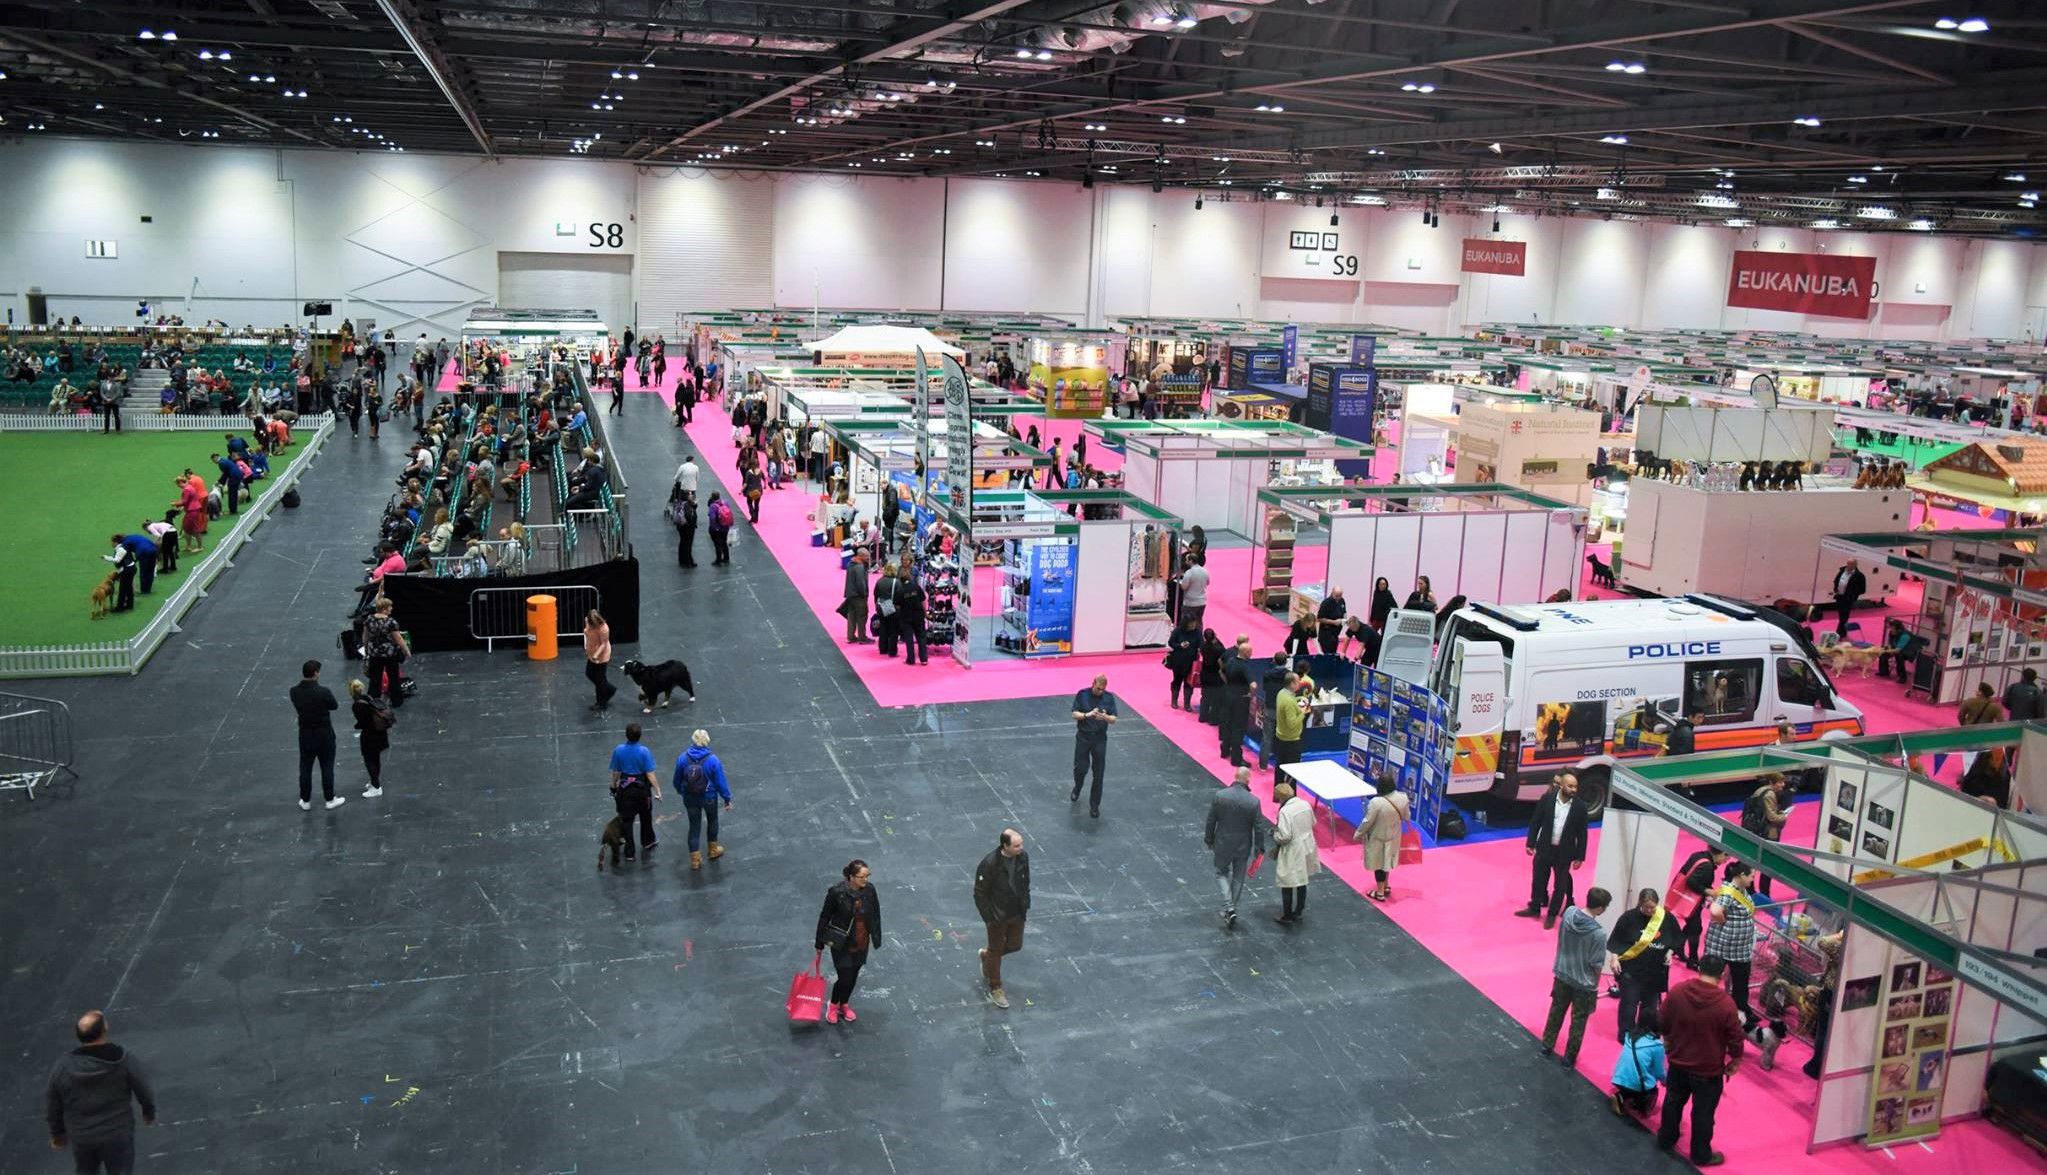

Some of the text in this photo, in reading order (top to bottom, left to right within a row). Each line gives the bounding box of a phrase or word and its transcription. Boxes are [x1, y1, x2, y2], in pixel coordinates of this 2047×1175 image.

[589, 222, 624, 249] S8
[1332, 254, 1359, 277] S9
[1465, 249, 1521, 266] EUKANUBA
[1738, 269, 1860, 298] EUKANUBA
[1628, 641, 1721, 659] POLICE
[1471, 692, 1494, 704] POLICE
[1577, 687, 1637, 700] DOG SECTION
[1472, 703, 1491, 714] DOGS
[2001, 978, 2039, 1006] Whippet
